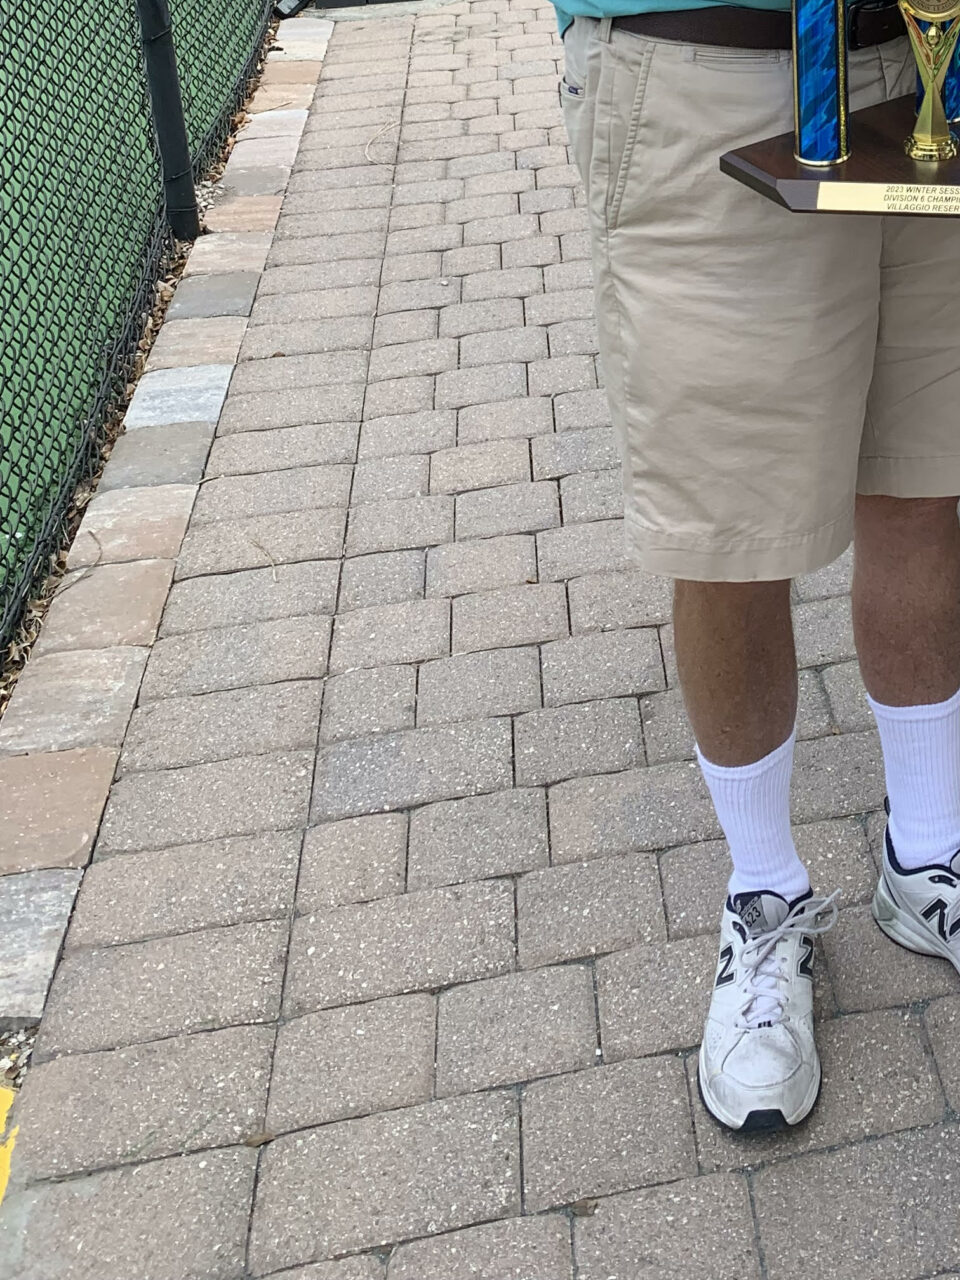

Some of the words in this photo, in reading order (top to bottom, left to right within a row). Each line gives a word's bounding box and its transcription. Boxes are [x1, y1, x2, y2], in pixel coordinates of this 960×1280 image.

[906, 186, 937, 194] WINTER
[884, 194, 919, 202] DIVISION
[887, 203, 930, 211] VILLAGGIO
